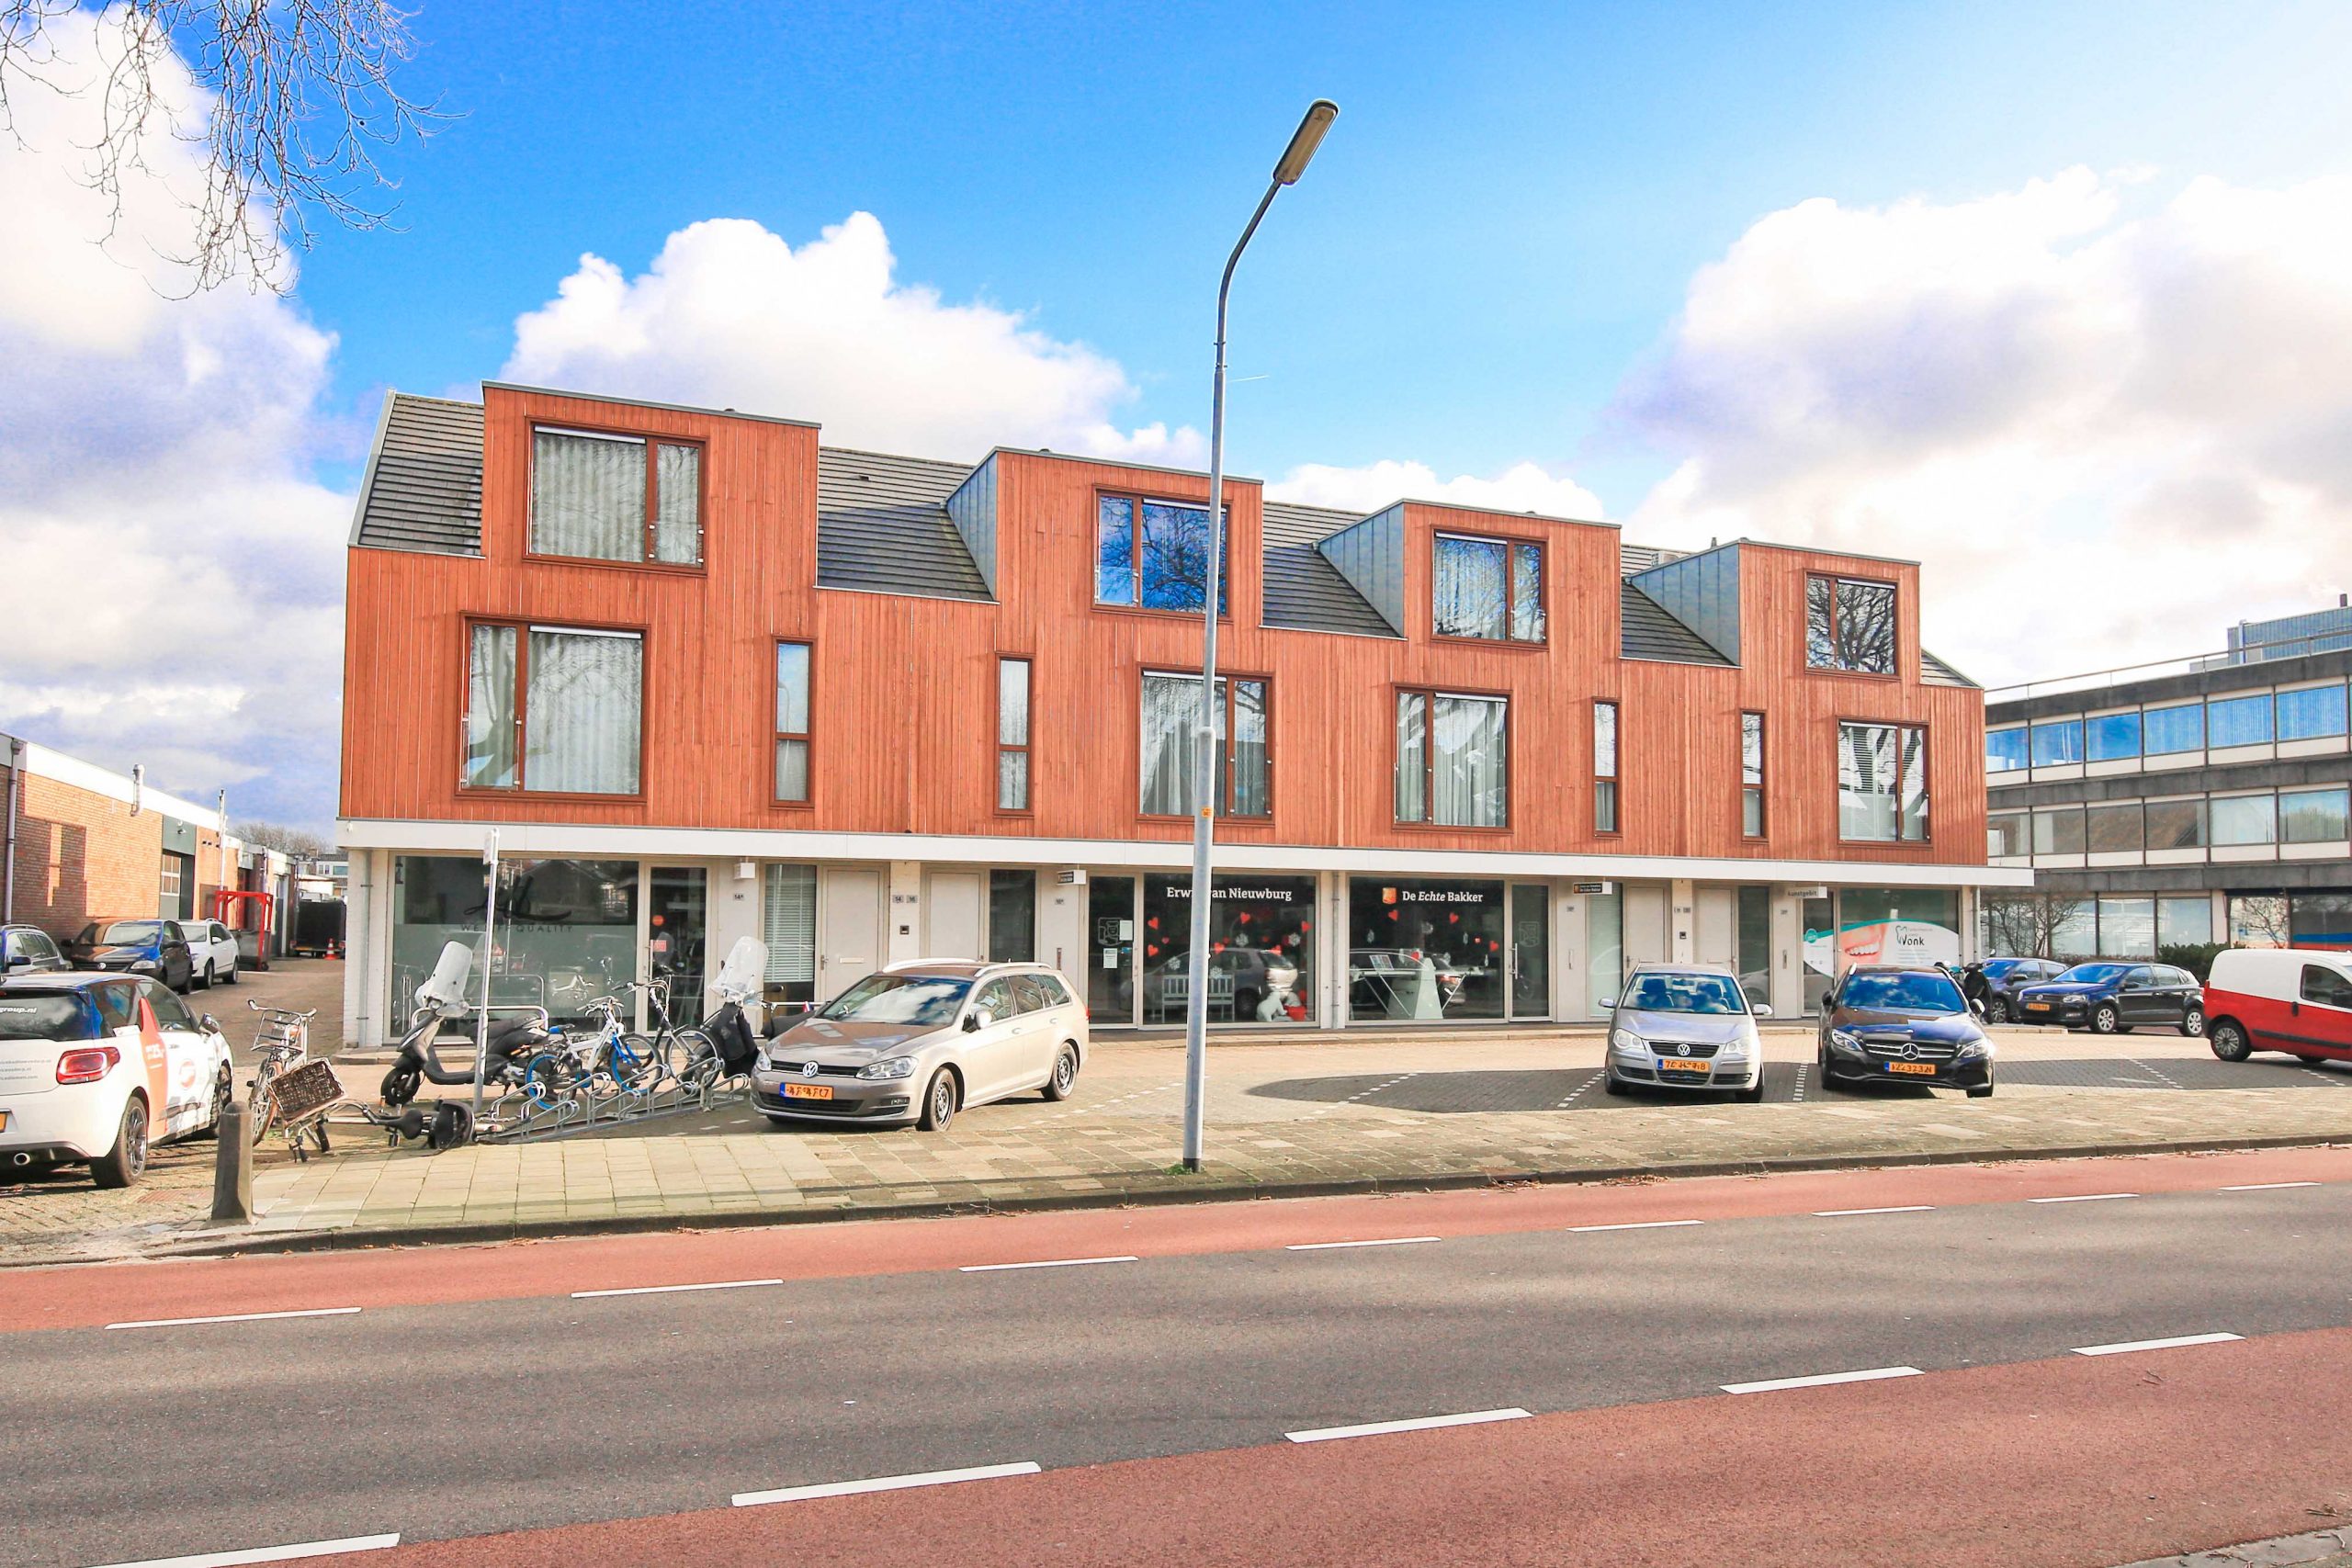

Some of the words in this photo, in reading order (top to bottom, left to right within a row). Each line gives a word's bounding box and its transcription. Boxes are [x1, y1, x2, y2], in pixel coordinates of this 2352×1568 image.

[1166, 886, 1193, 898] Erw
[1210, 889, 1227, 898] an
[1228, 887, 1293, 901] Nieuwburg
[1402, 890, 1417, 901] De
[1418, 891, 1446, 902] Echte
[1447, 891, 1484, 902] Bakker
[515, 925, 573, 933] QUALITY
[1902, 933, 1926, 946] Vonk
